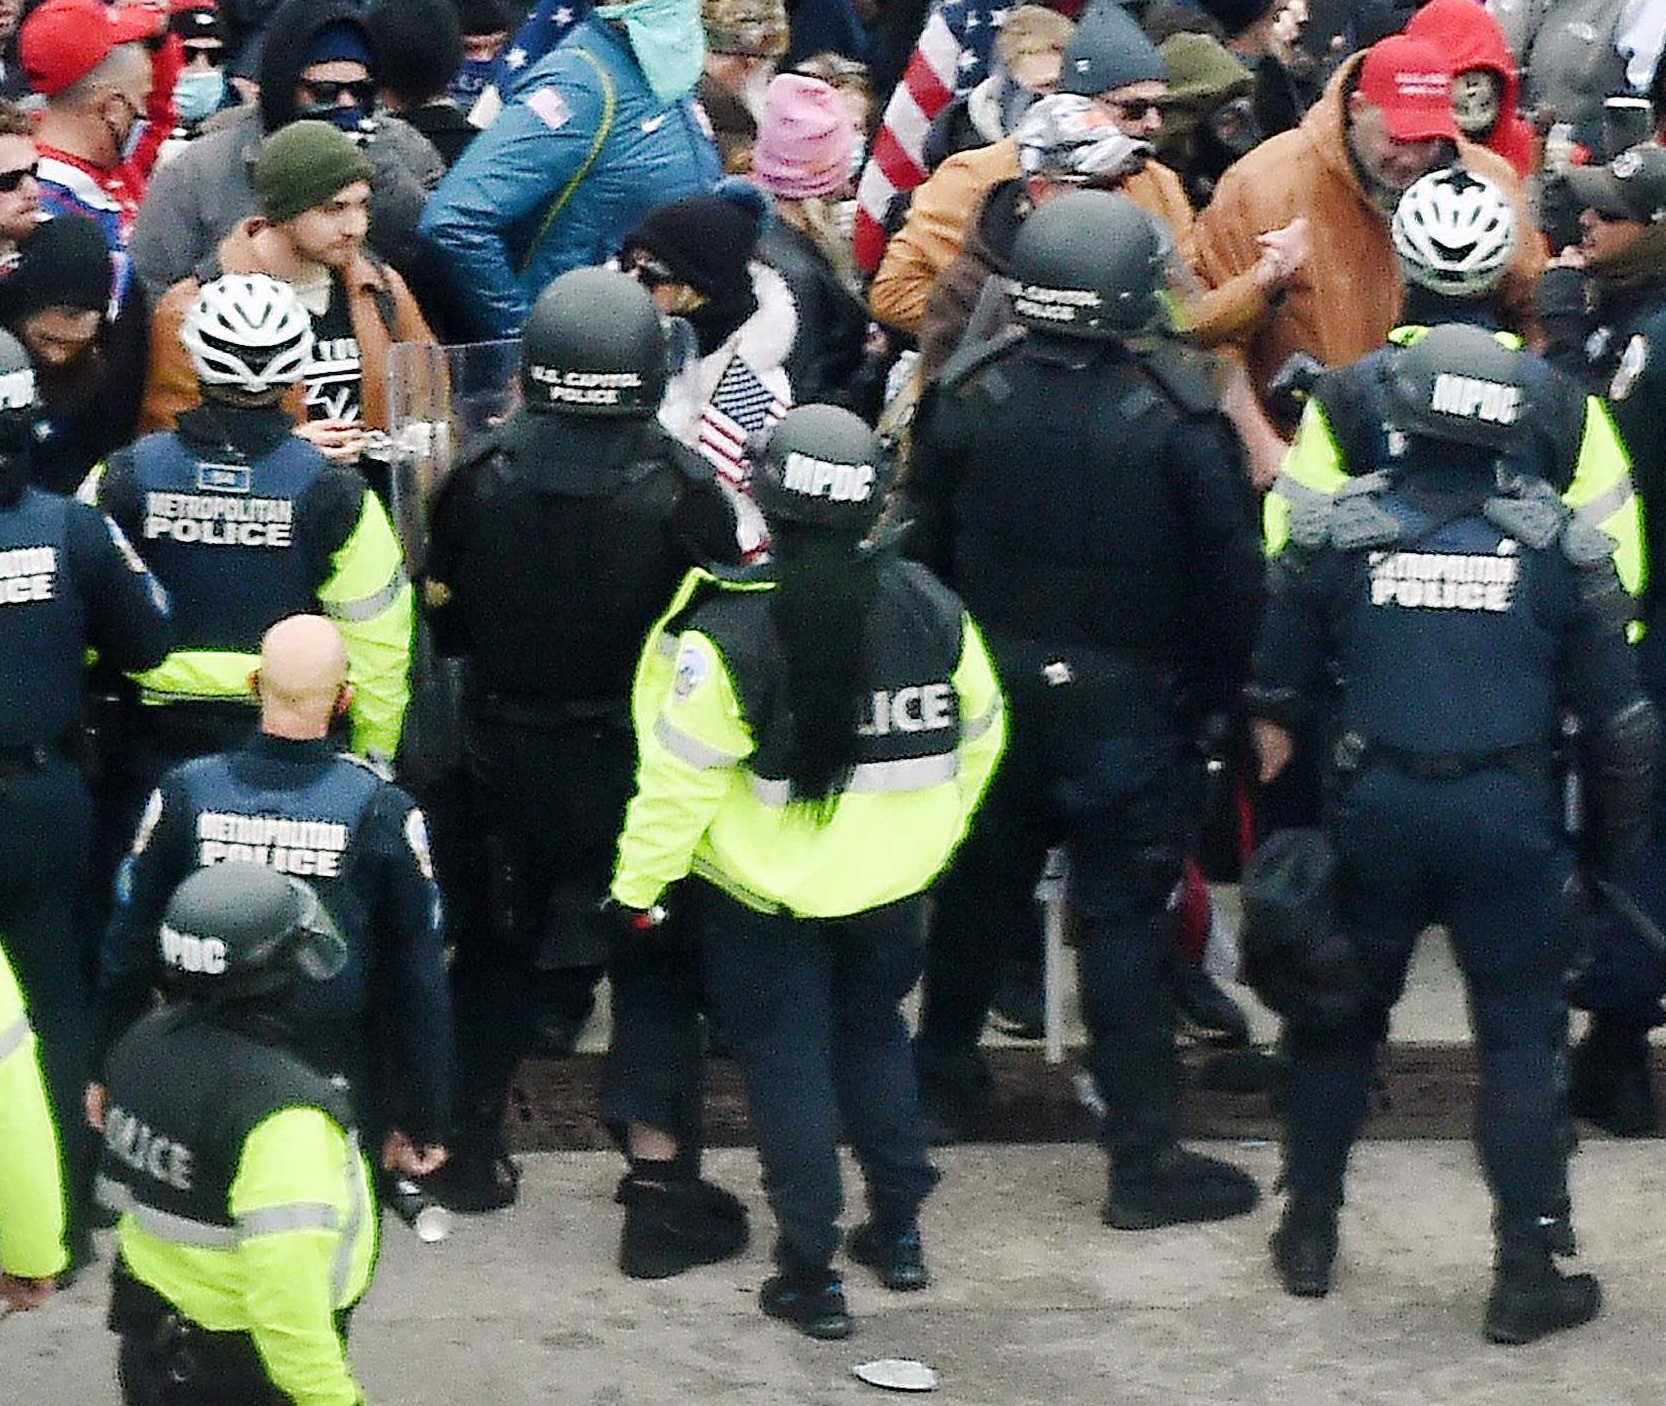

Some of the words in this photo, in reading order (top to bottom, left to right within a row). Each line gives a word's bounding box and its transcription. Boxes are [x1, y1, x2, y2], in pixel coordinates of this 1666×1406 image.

[145, 494, 294, 524] METROPOLITAN
[144, 516, 294, 548] POLICE
[857, 681, 953, 737] LICE
